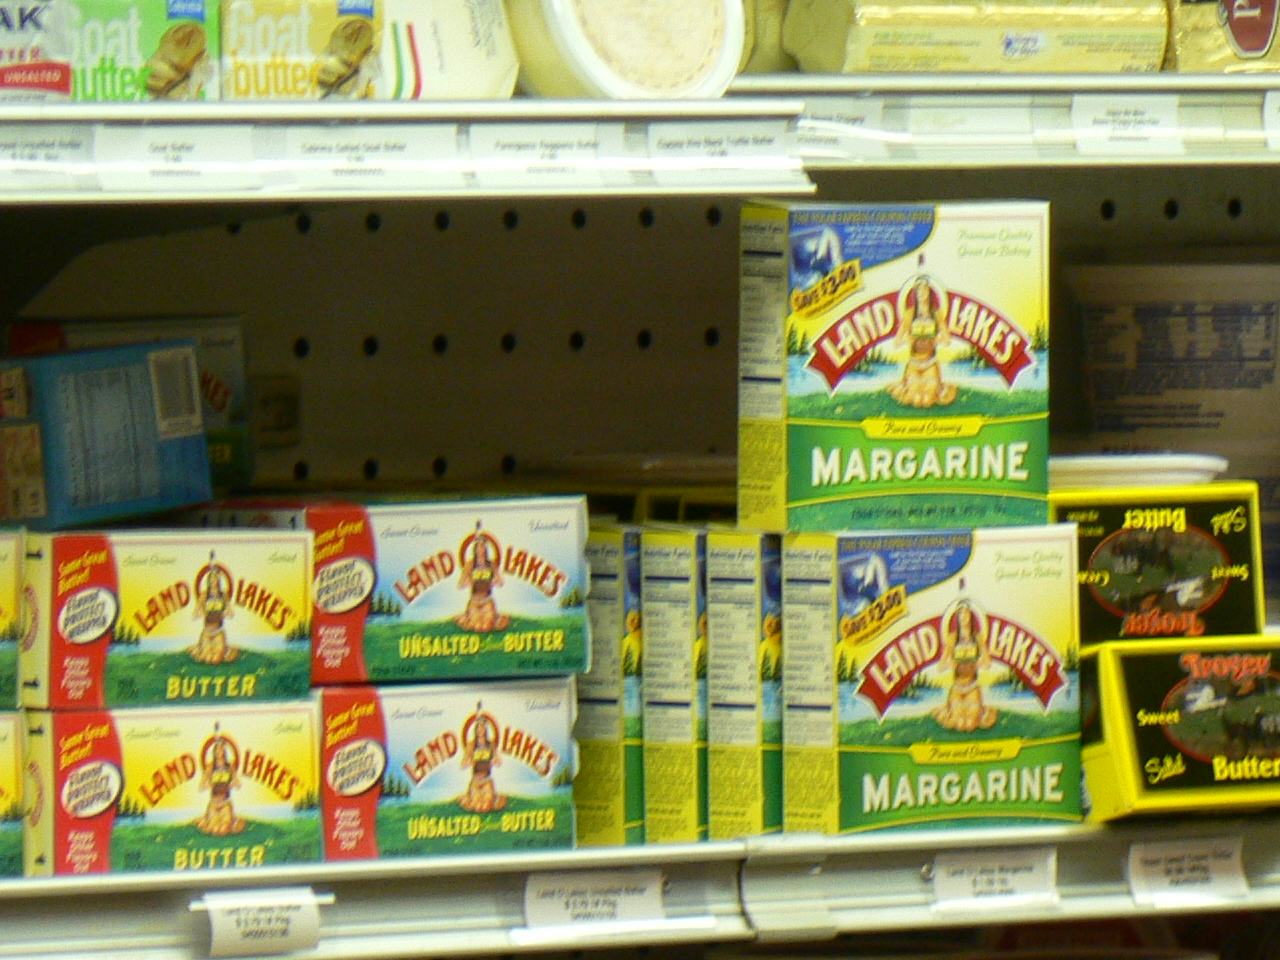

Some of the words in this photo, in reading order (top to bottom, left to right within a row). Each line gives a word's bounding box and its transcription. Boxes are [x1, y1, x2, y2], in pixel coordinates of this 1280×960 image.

[231, 48, 320, 98] butter
[821, 298, 896, 369] LAND
[948, 296, 1022, 364] LAKES
[811, 441, 1030, 487] MARGARINE
[1123, 507, 1187, 533] Butter
[393, 549, 456, 605] LAND
[502, 545, 568, 599] LAKES
[133, 580, 191, 636] LAND
[234, 578, 293, 632] LAKES
[399, 634, 481, 659] UNSALTED
[502, 629, 566, 654] BUTTER
[869, 624, 940, 695] LAND
[989, 620, 1054, 684] LAKES
[165, 673, 260, 700] BUTTER
[1136, 708, 1181, 727] Sweet
[138, 751, 197, 808] LAND
[241, 749, 300, 802] LAKES
[402, 731, 459, 785] LAND
[500, 726, 561, 778] LAKES
[862, 762, 1064, 814] MARGARINE
[407, 816, 482, 841] UNSALTED
[500, 808, 556, 833] BUTTER
[173, 845, 268, 871] BUTTER
